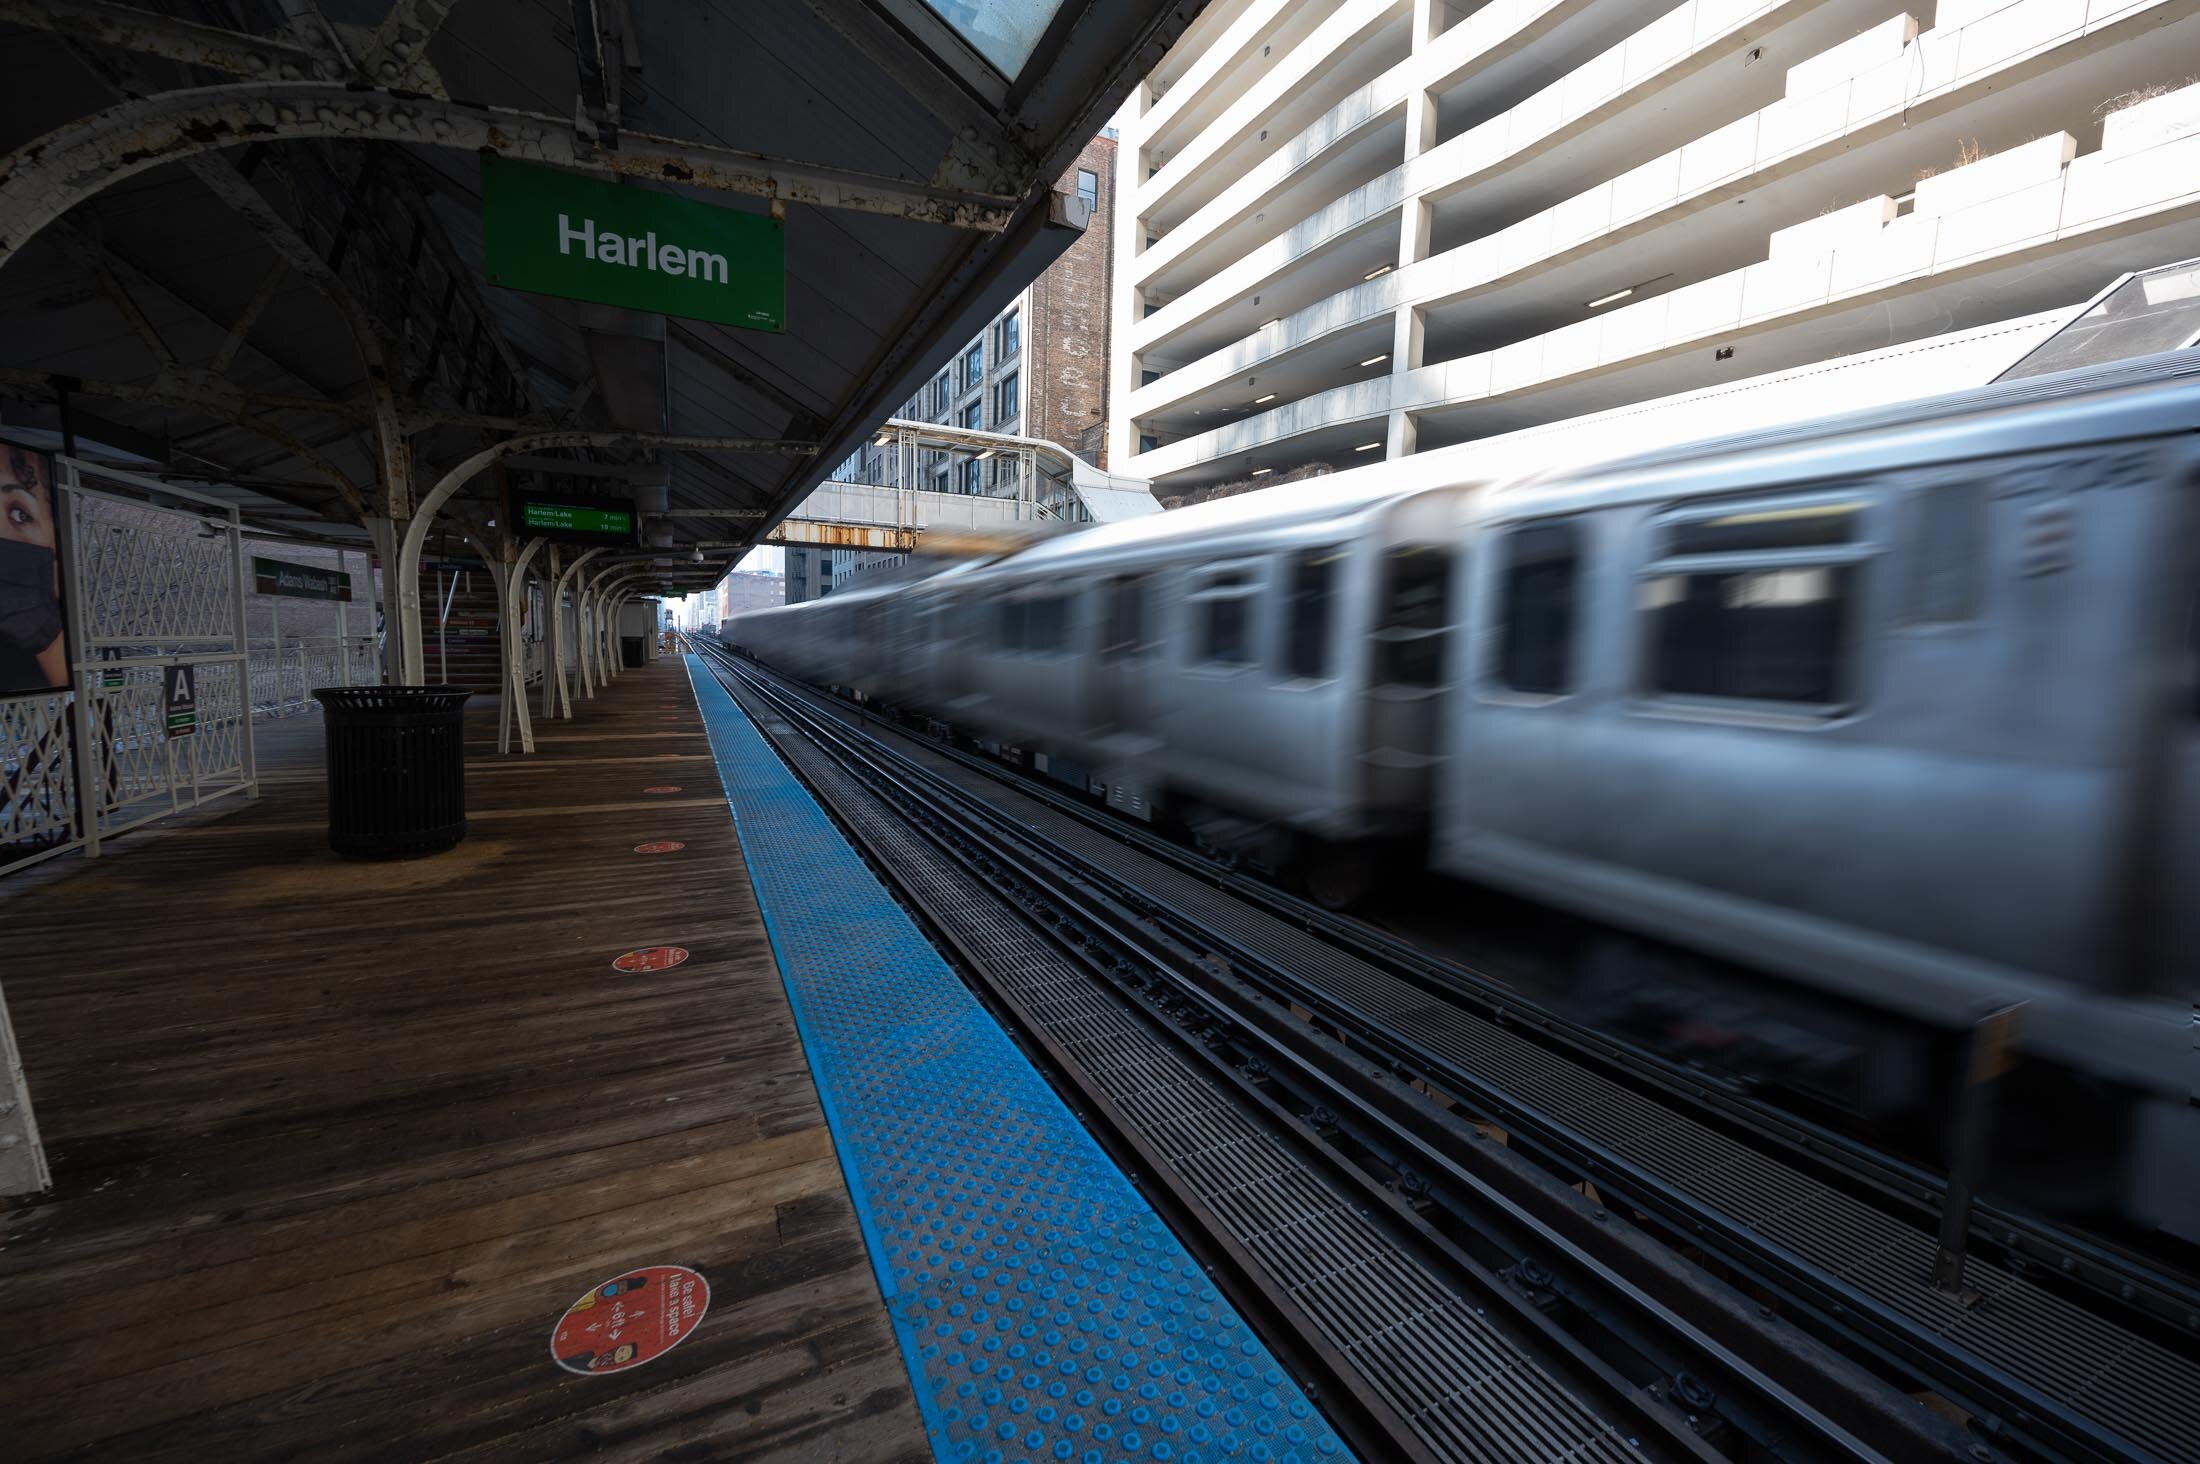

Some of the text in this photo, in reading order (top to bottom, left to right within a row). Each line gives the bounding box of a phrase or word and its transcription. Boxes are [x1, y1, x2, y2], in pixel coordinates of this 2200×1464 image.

[558, 213, 728, 284] Harlem
[527, 509, 573, 518] Harlem/Lake
[609, 513, 622, 521] min
[528, 518, 573, 529] Harlem/Lake
[173, 669, 191, 702] A
[682, 1279, 696, 1319] Be safe!
[666, 1305, 680, 1337] space
